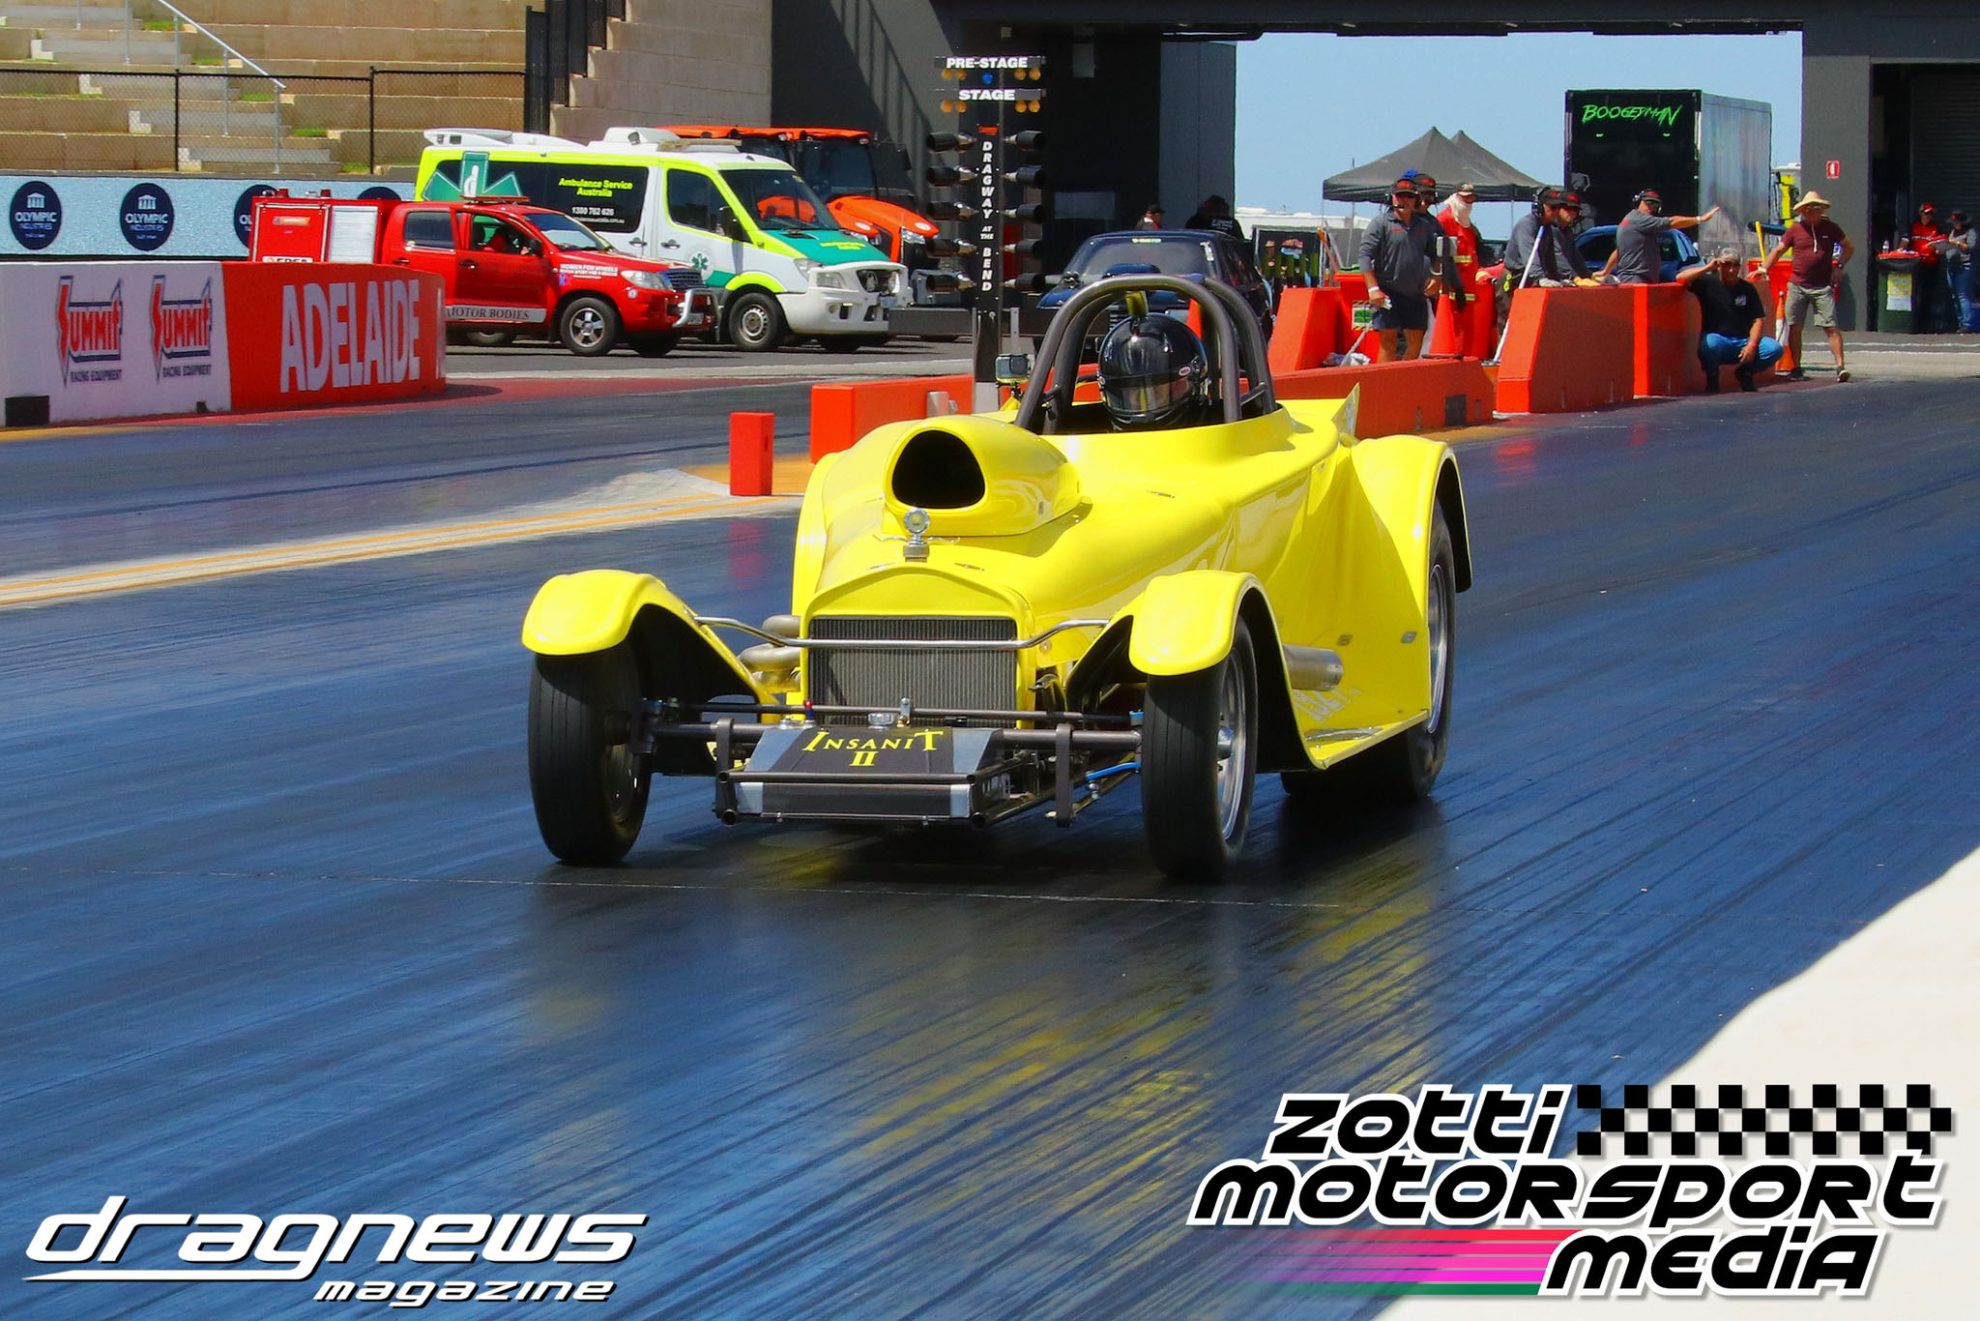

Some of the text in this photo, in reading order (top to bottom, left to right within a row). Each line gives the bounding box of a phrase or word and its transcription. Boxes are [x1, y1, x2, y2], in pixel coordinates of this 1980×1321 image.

[946, 57, 1028, 69] PRE-STAGE
[958, 89, 1016, 101] STAGE
[558, 177, 633, 190] Ambulance Service
[981, 141, 994, 220] DRAGWAY
[576, 187, 613, 198] Australia
[15, 211, 57, 222] OLYMPIC
[125, 213, 169, 224] OLYMPIC
[981, 225, 993, 233] AT
[981, 246, 993, 292] BEND
[151, 276, 212, 362] SUMMIT
[489, 308, 530, 320] BODIES
[57, 277, 122, 366] SUMMIT
[280, 278, 420, 393] ADELAIDE
[848, 751, 879, 767] II
